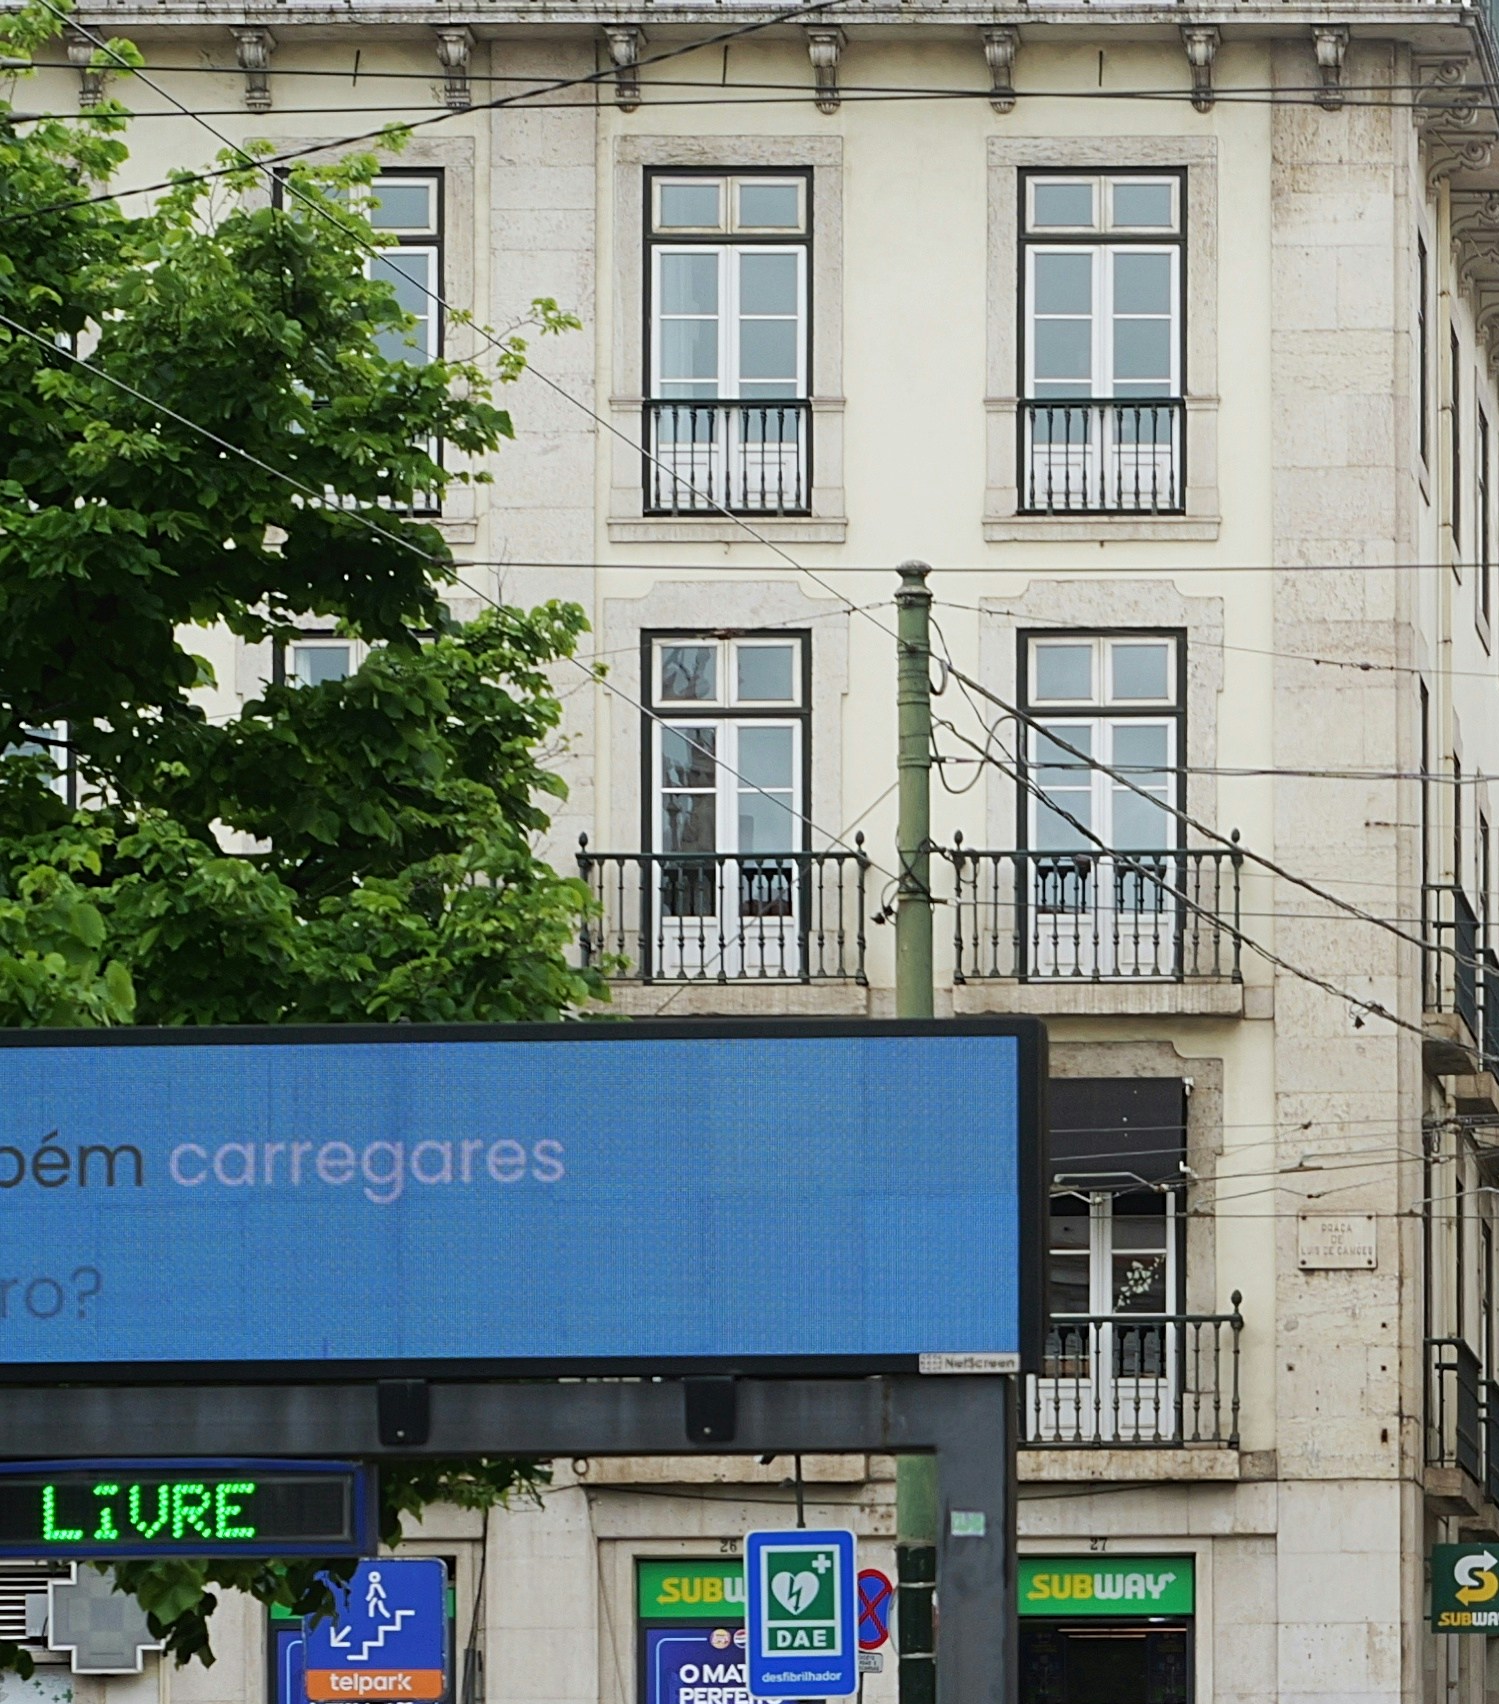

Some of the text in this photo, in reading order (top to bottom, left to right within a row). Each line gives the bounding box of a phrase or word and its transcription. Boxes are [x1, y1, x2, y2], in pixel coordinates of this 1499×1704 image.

[168, 1138, 567, 1204] carregares
[720, 1539, 737, 1552] 26
[1090, 1538, 1107, 1551] 27
[656, 1576, 744, 1605] SUBW
[1027, 1571, 1177, 1601] SUBWAY
[776, 1630, 827, 1648] DAE
[330, 1672, 412, 1696] telpark
[680, 1663, 746, 1684] O MAT
[762, 1671, 843, 1683] desfibrilhador
